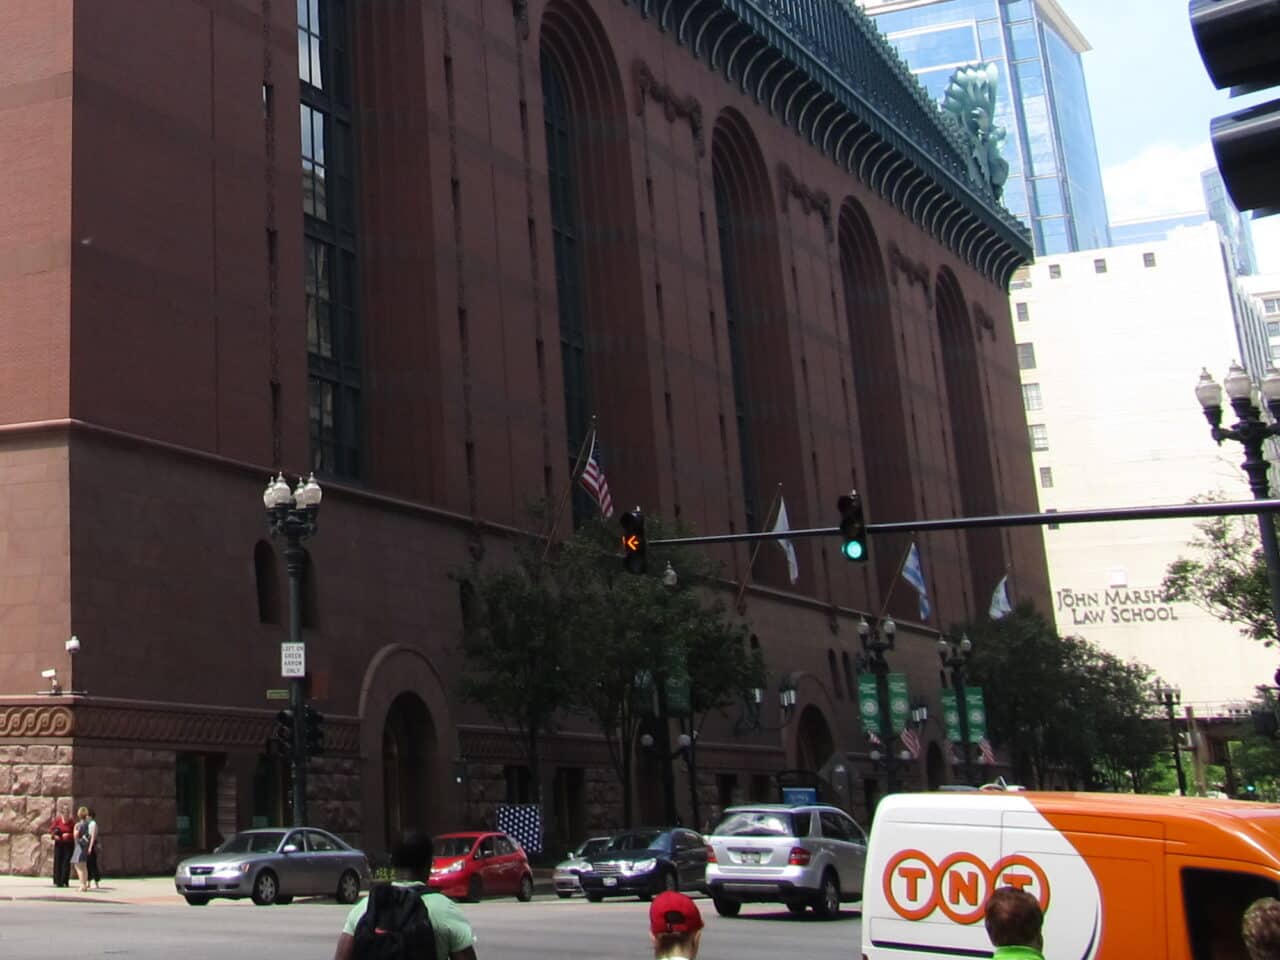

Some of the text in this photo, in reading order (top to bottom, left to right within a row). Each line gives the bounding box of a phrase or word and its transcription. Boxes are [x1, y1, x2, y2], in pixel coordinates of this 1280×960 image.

[1057, 589, 1163, 611] JOHN MARSH
[1071, 606, 1179, 625] LAW SCHOOL
